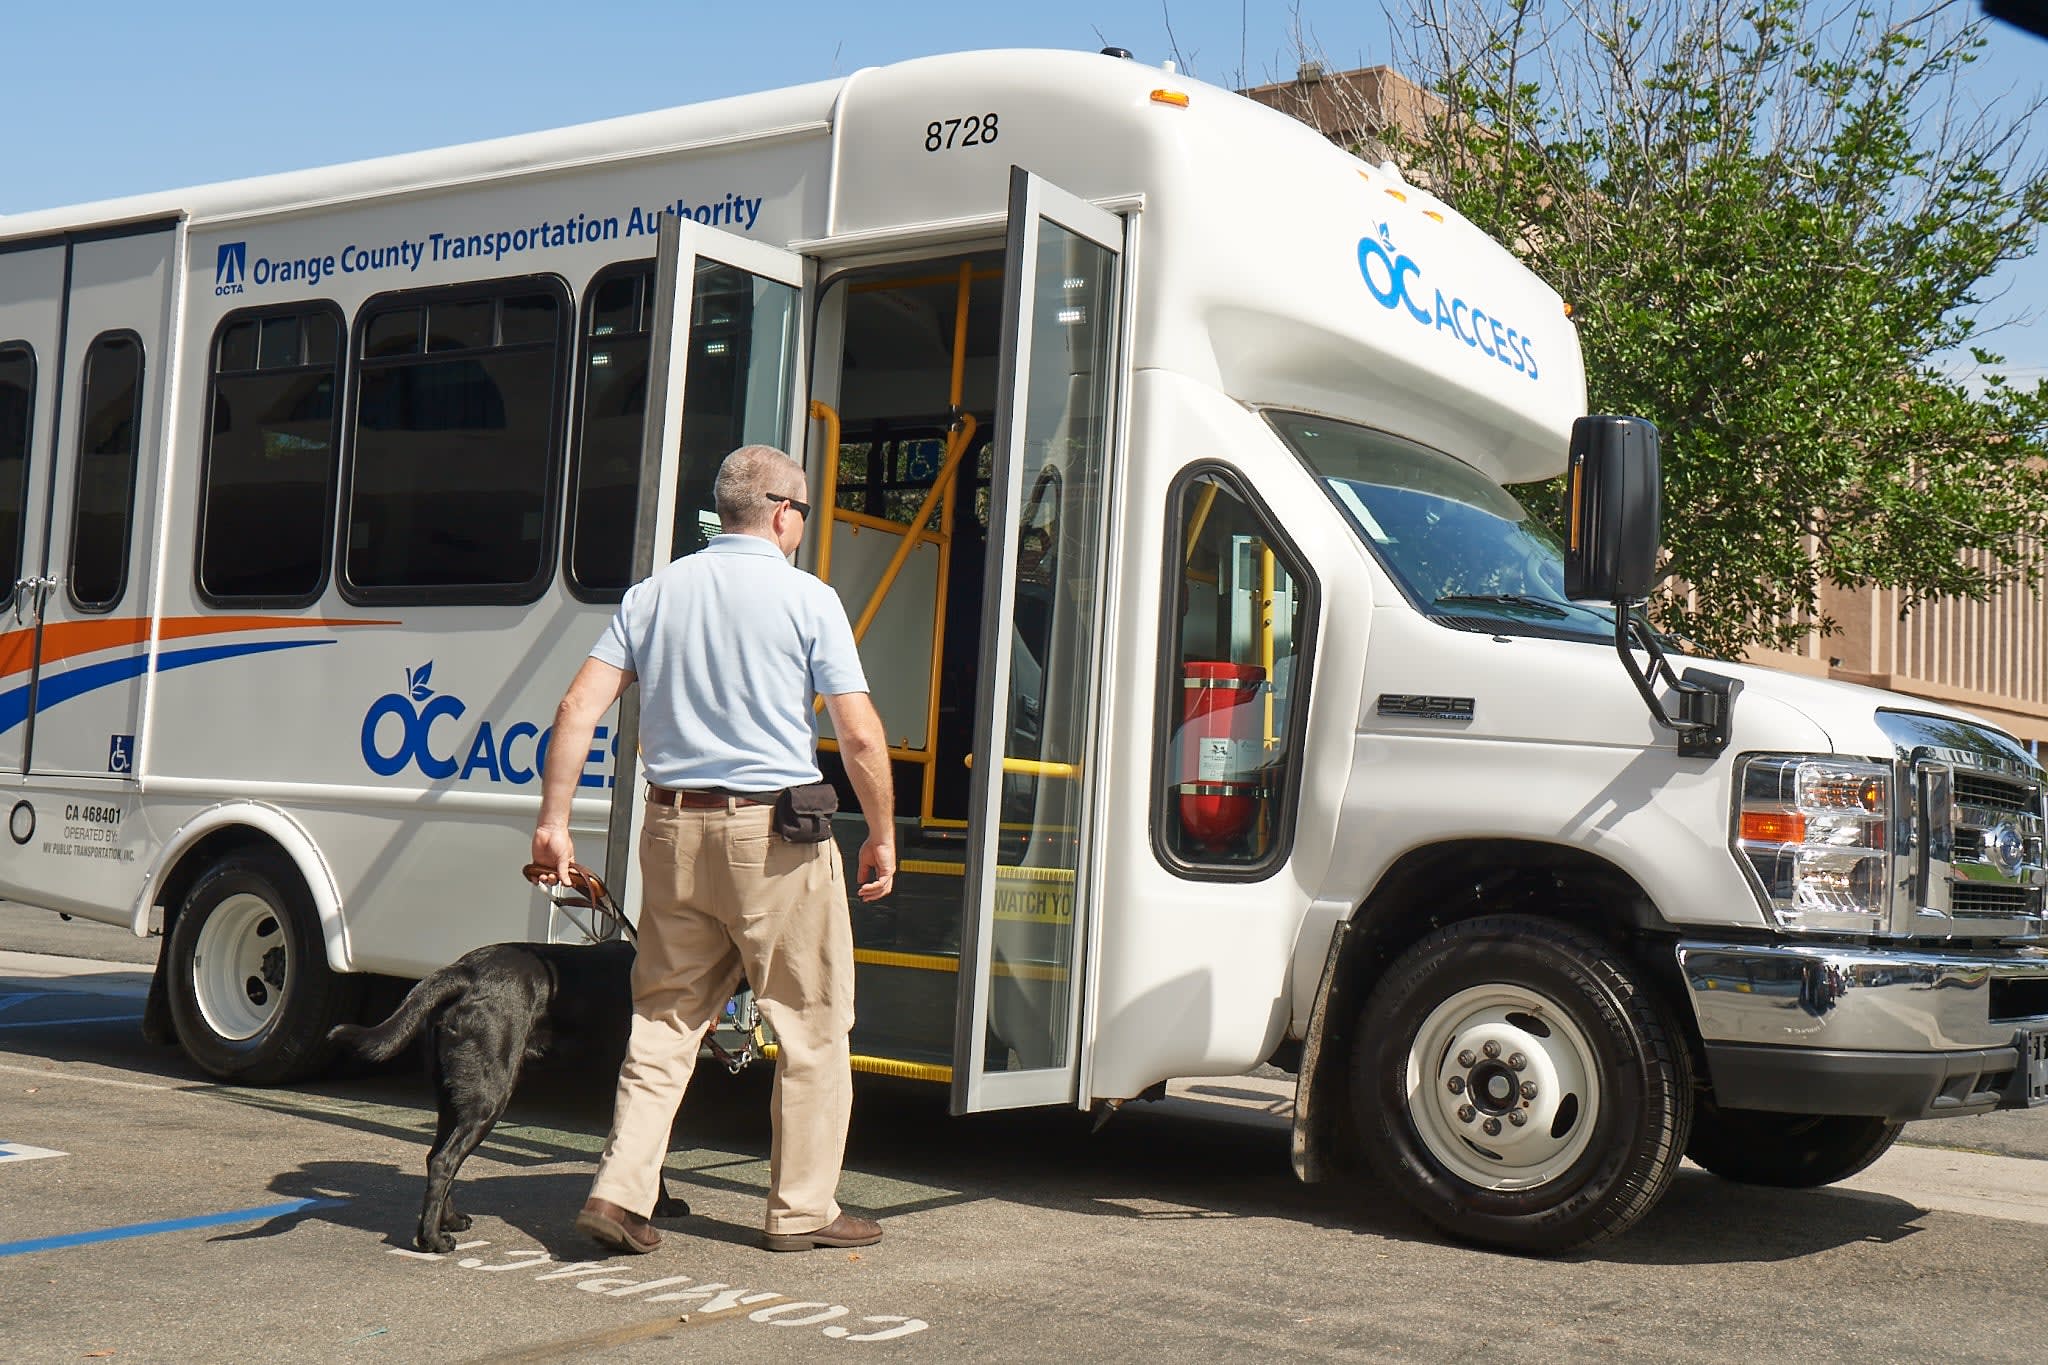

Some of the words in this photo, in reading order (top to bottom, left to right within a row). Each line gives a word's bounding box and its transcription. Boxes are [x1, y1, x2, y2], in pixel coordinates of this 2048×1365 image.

[925, 112, 998, 152] 8728
[253, 256, 335, 285] Orange
[341, 240, 424, 272] County
[429, 213, 618, 261] Transportation
[215, 284, 244, 296] OCTA
[1357, 236, 1433, 325] OC
[1435, 287, 1538, 381] ACCESS
[361, 693, 466, 780] OC
[65, 804, 79, 820] CA
[82, 806, 121, 824] 468401
[64, 826, 103, 841] OPERATED
[105, 830, 118, 842] BY:
[52, 843, 73, 856] PUBLIC
[123, 849, 135, 861] INC.
[994, 889, 1046, 914] WATCH
